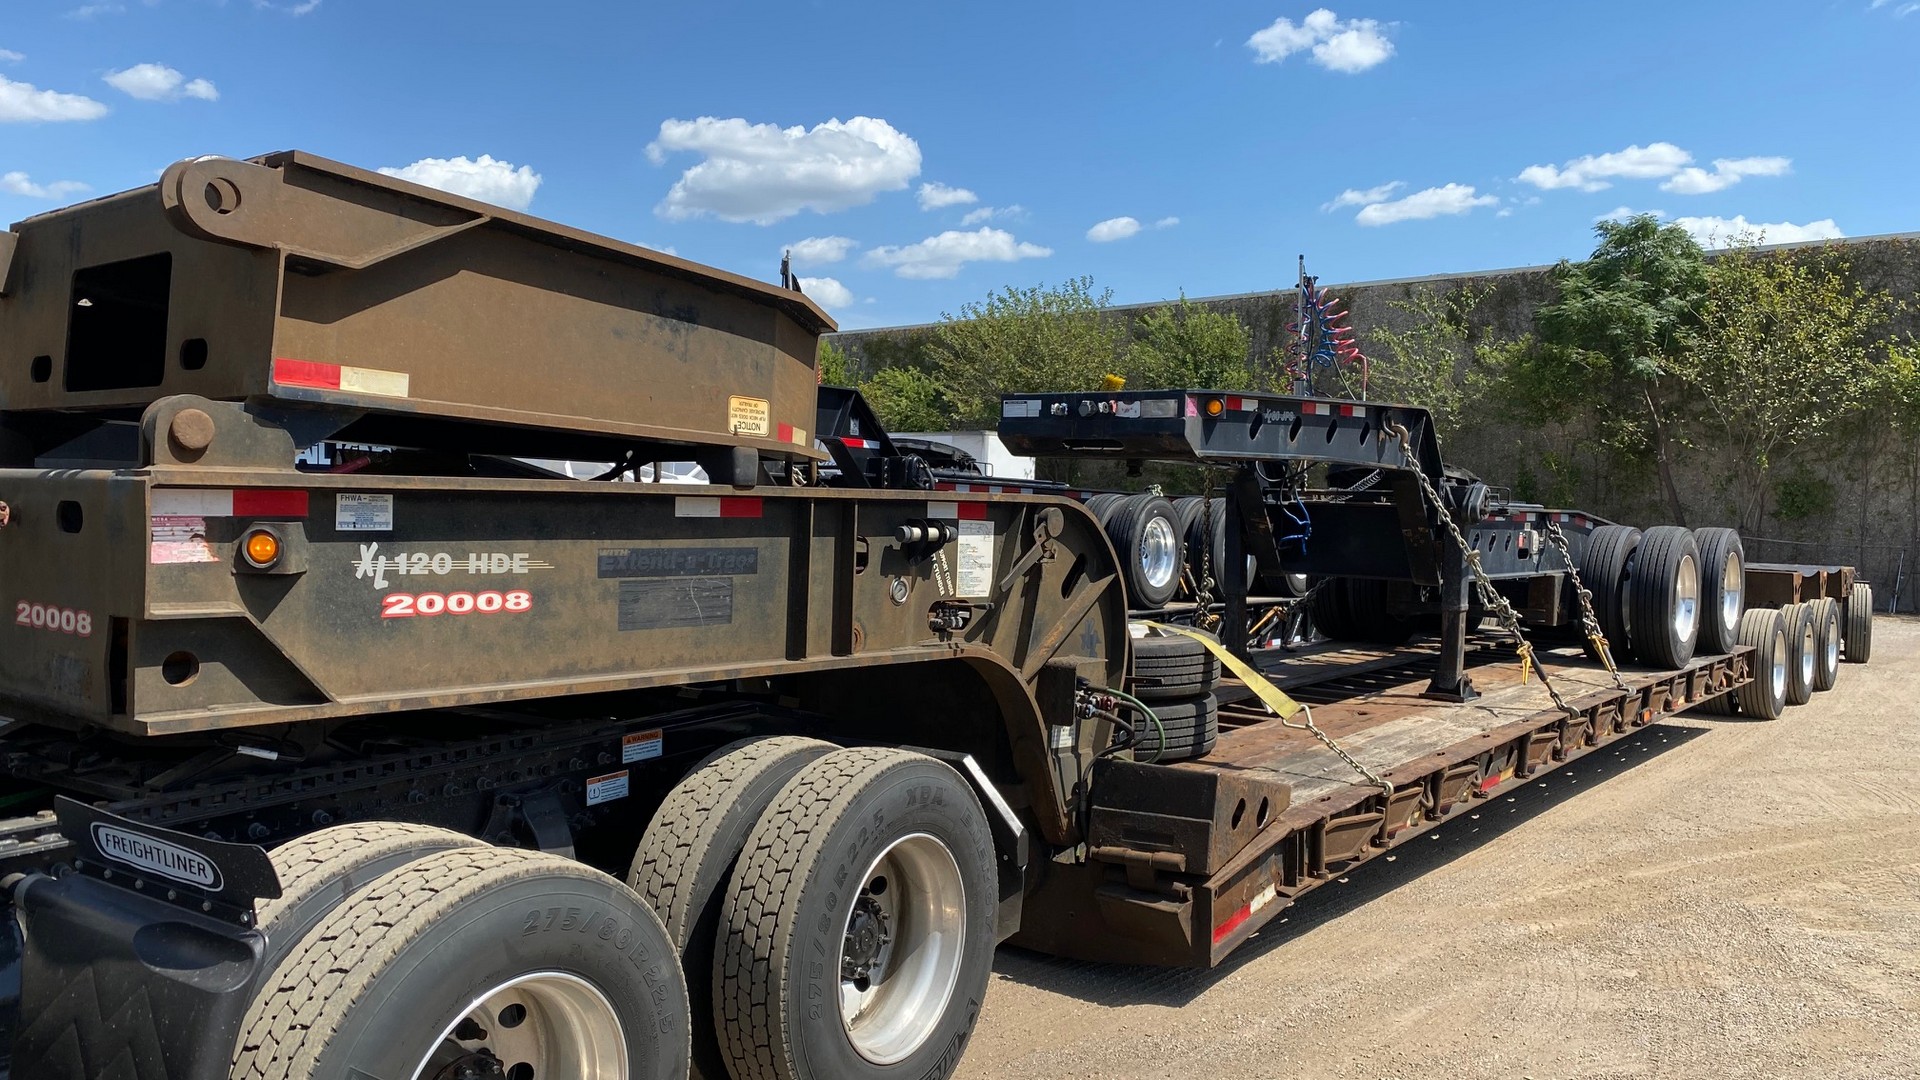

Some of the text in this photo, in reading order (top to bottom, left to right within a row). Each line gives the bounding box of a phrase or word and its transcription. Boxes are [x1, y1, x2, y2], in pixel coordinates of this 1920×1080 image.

[737, 421, 760, 431] NOTICE
[468, 552, 529, 574] HDE
[933, 563, 945, 596] CYLINDER
[381, 590, 532, 618] 20008
[16, 602, 92, 637] 20008
[631, 731, 659, 742] WARNING
[105, 833, 208, 879] FREIGHTLINER
